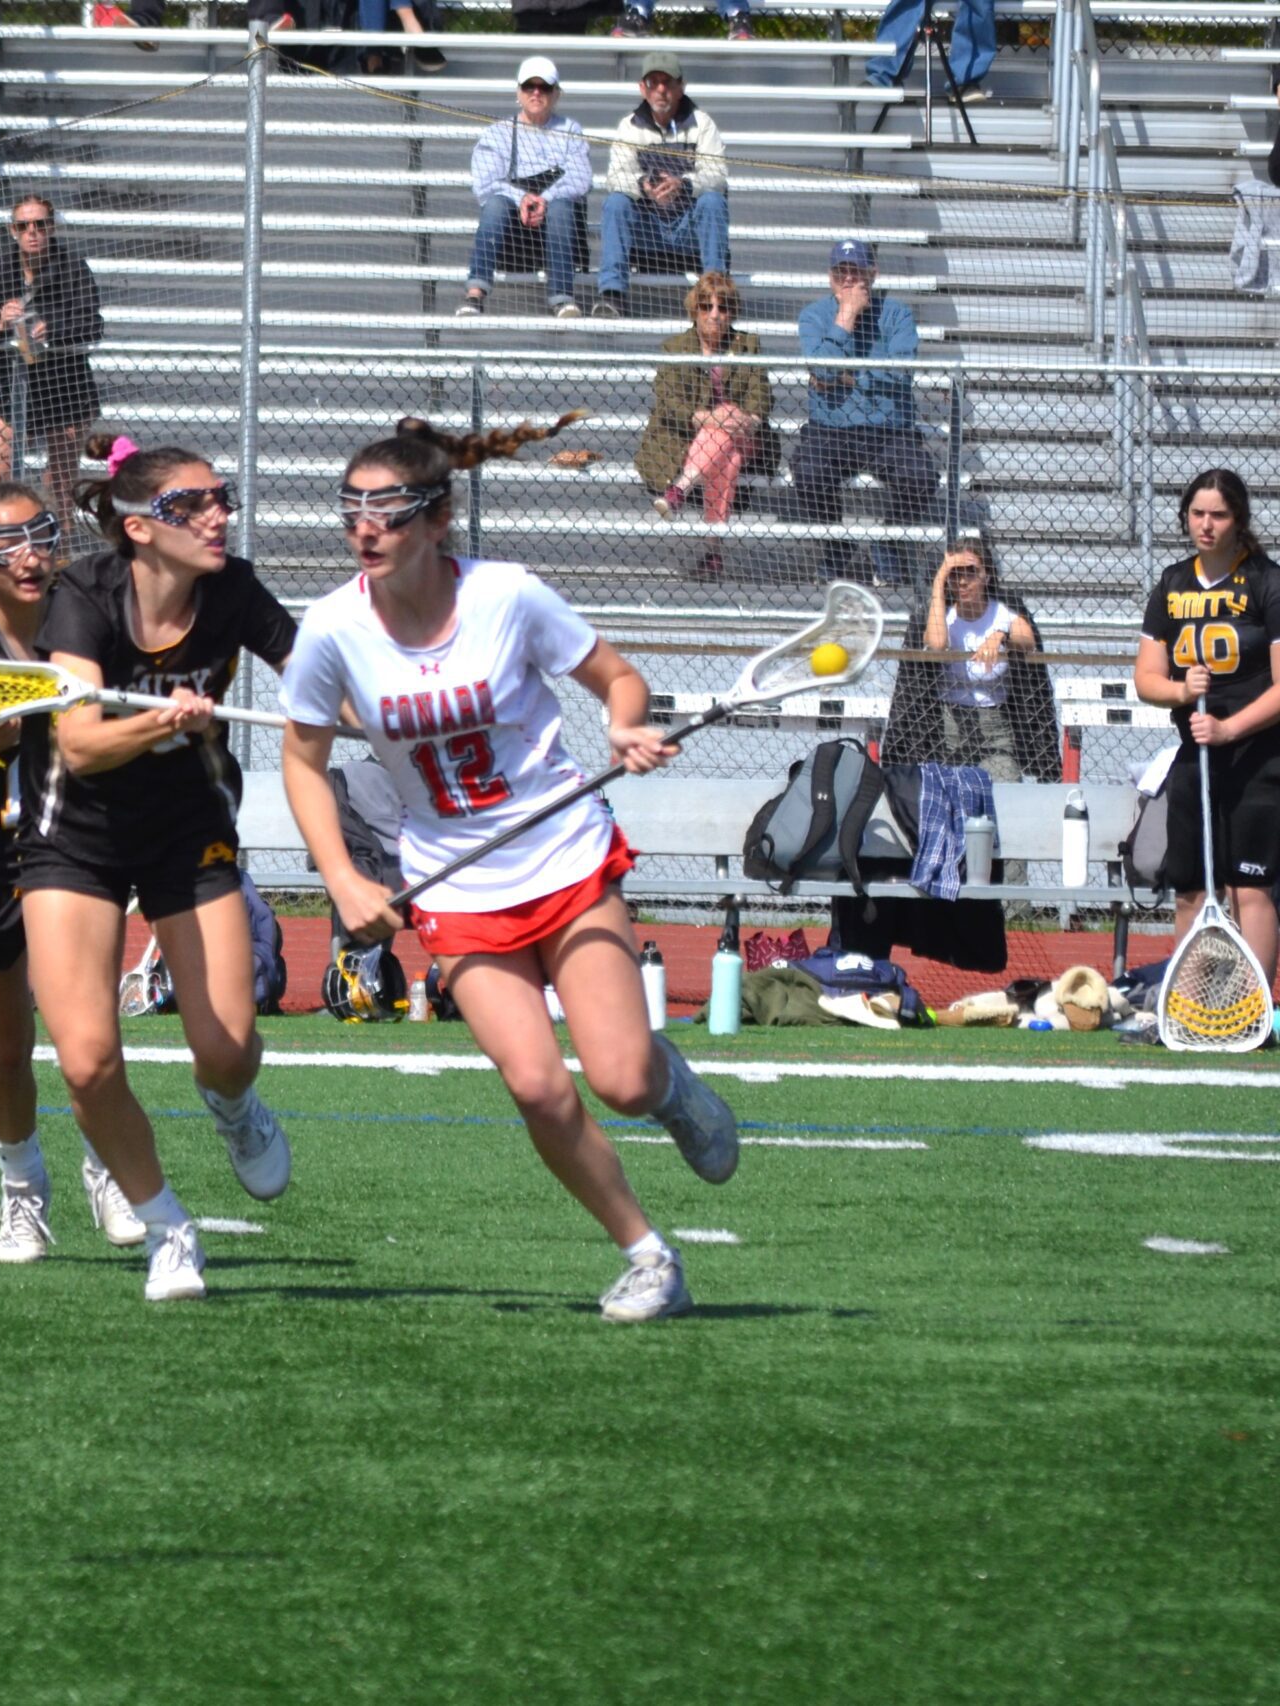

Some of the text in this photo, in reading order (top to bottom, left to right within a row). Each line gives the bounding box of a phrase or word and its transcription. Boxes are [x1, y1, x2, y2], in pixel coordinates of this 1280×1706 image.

[1167, 591, 1248, 618] AMITY
[1173, 622, 1240, 675] 40
[410, 730, 514, 818] 12
[1238, 862, 1267, 876] STX
